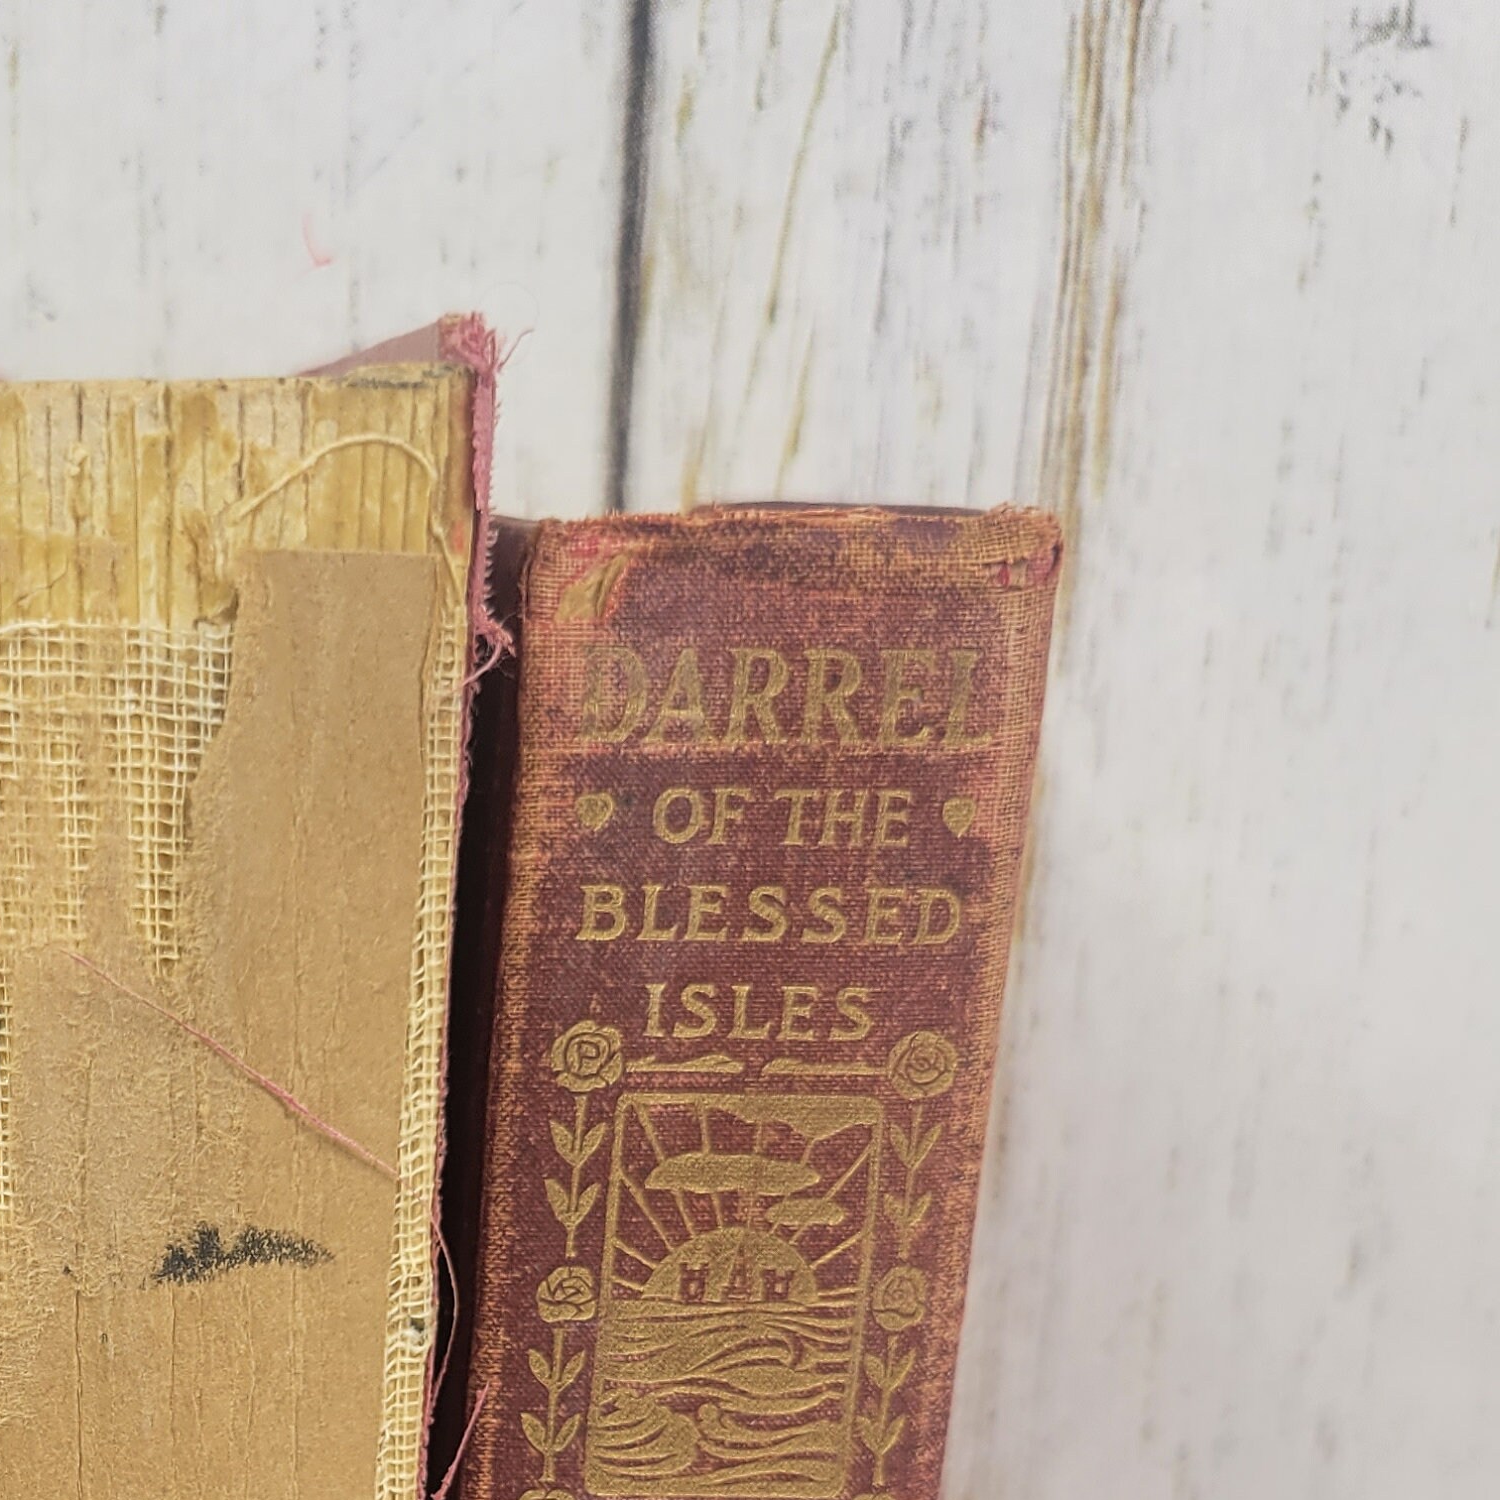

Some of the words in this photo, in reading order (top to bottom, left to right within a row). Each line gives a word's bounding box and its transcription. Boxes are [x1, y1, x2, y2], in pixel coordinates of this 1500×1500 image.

[574, 644, 996, 750] DARREL
[652, 788, 756, 847] OF
[775, 788, 913, 849] THE
[575, 884, 963, 945] BLESSED
[642, 984, 876, 1042] ISLES
